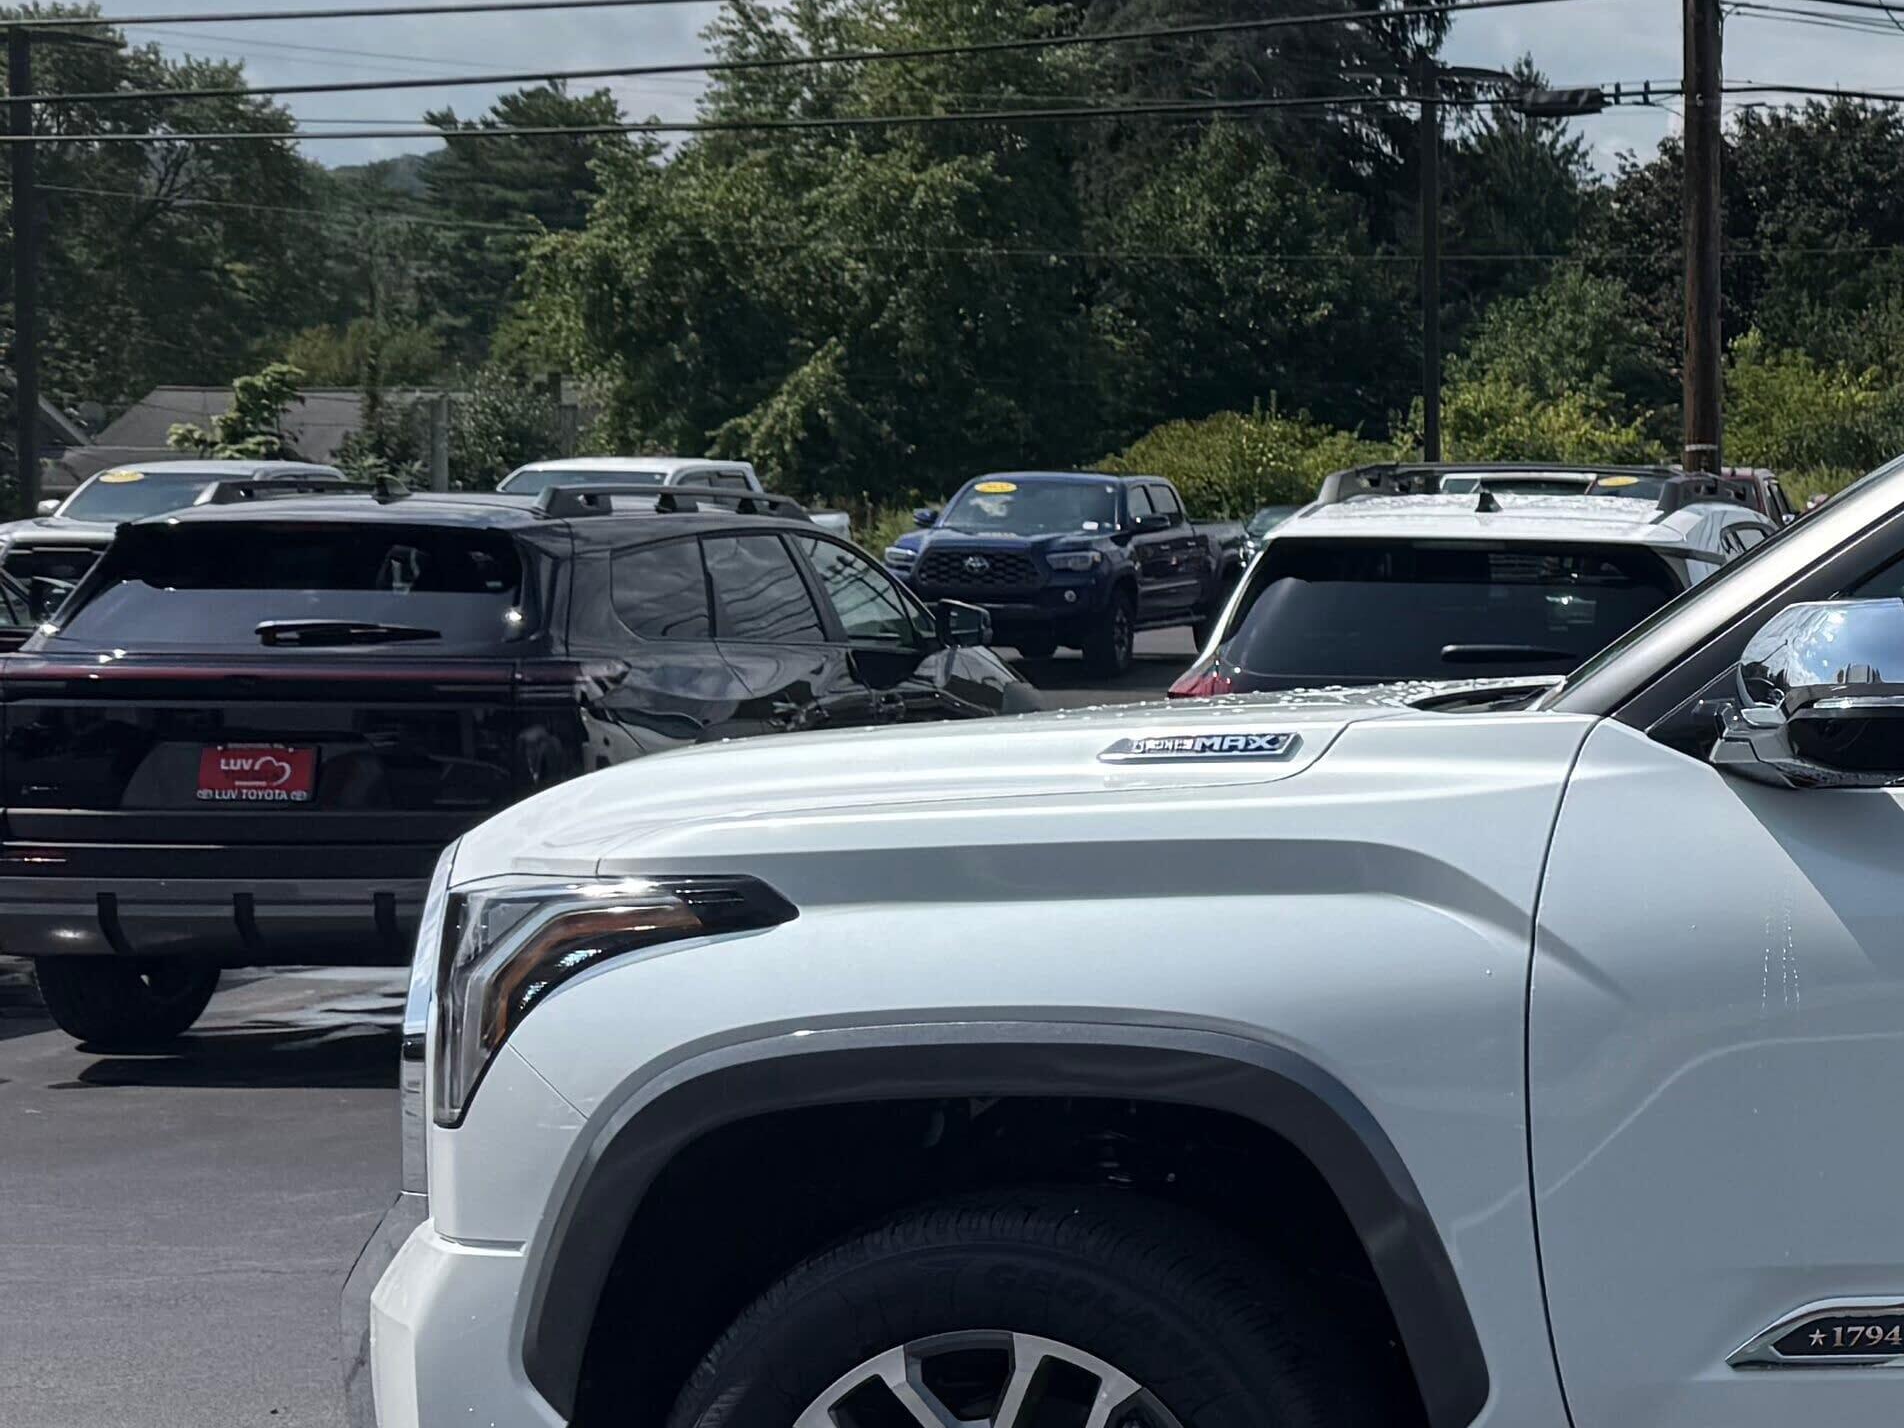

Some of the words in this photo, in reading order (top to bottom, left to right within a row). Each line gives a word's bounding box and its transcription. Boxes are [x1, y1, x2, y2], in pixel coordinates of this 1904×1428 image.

[220, 758, 253, 770] LUV
[215, 789, 238, 800] LUV
[240, 789, 288, 800] TOYOTA
[1832, 1325, 1902, 1347] 1794
